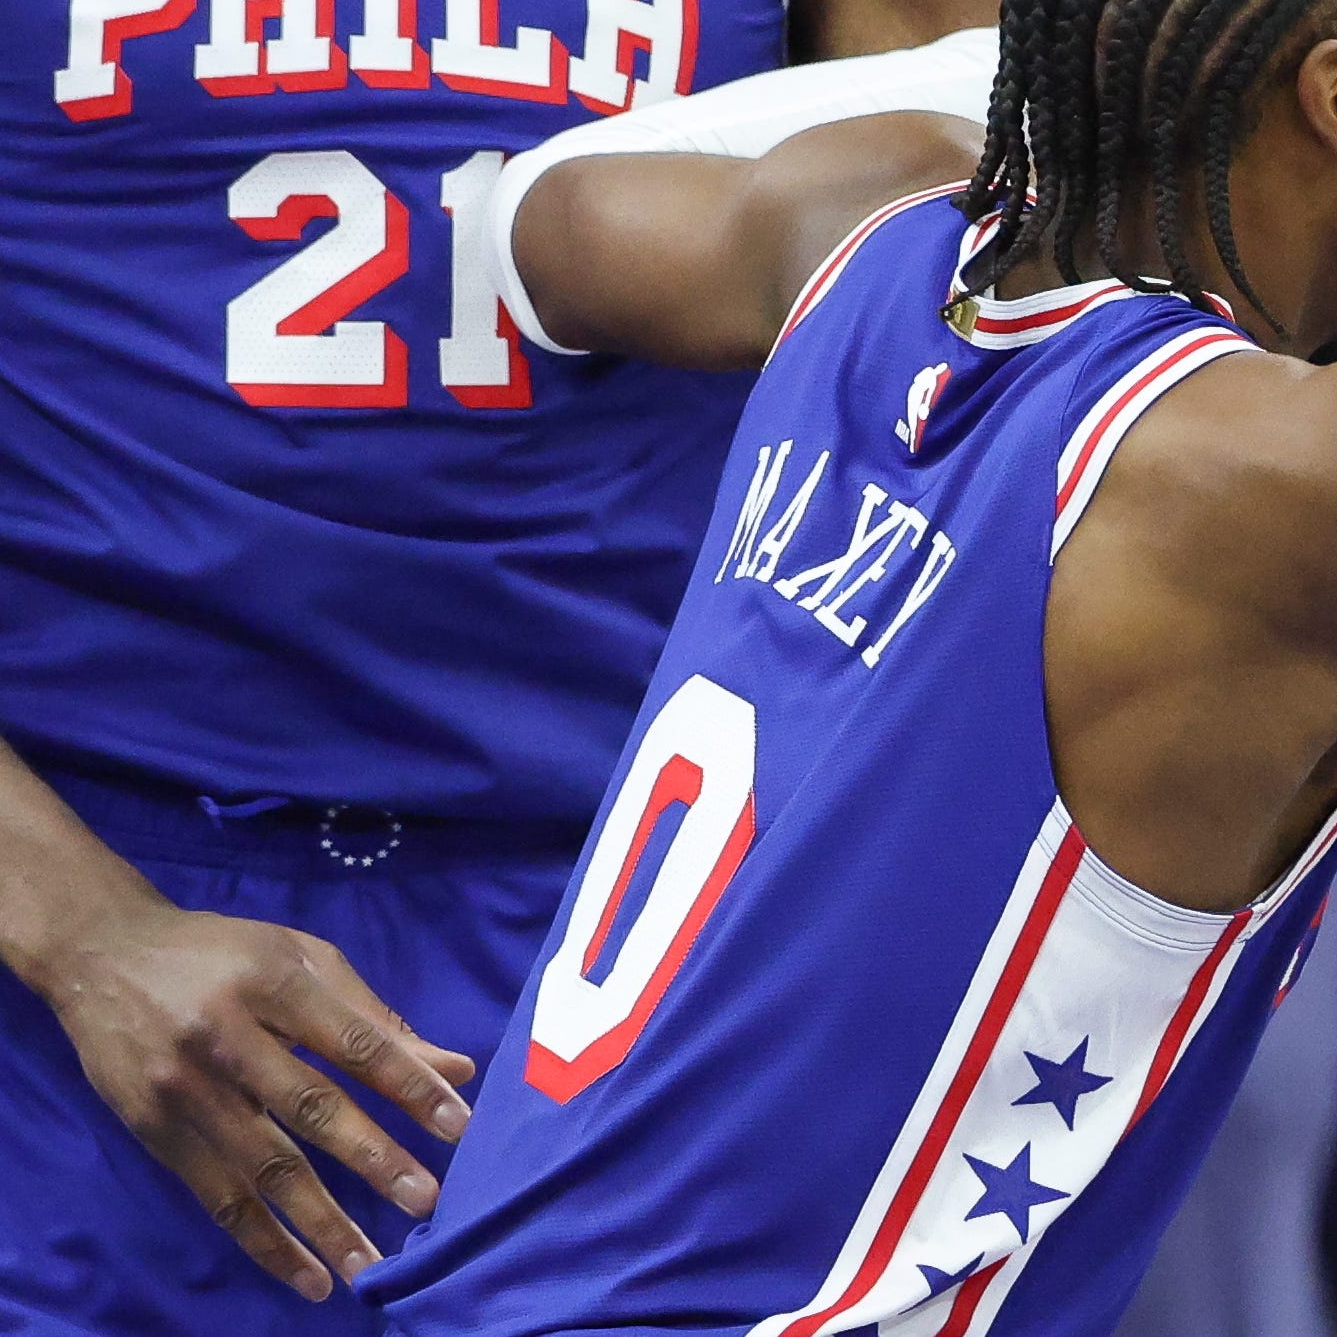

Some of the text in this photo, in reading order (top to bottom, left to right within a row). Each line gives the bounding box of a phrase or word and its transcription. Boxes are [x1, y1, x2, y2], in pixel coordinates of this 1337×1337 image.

[226, 150, 532, 408] 21
[715, 438, 957, 668] MAXEY
[525, 674, 756, 1106] 0
